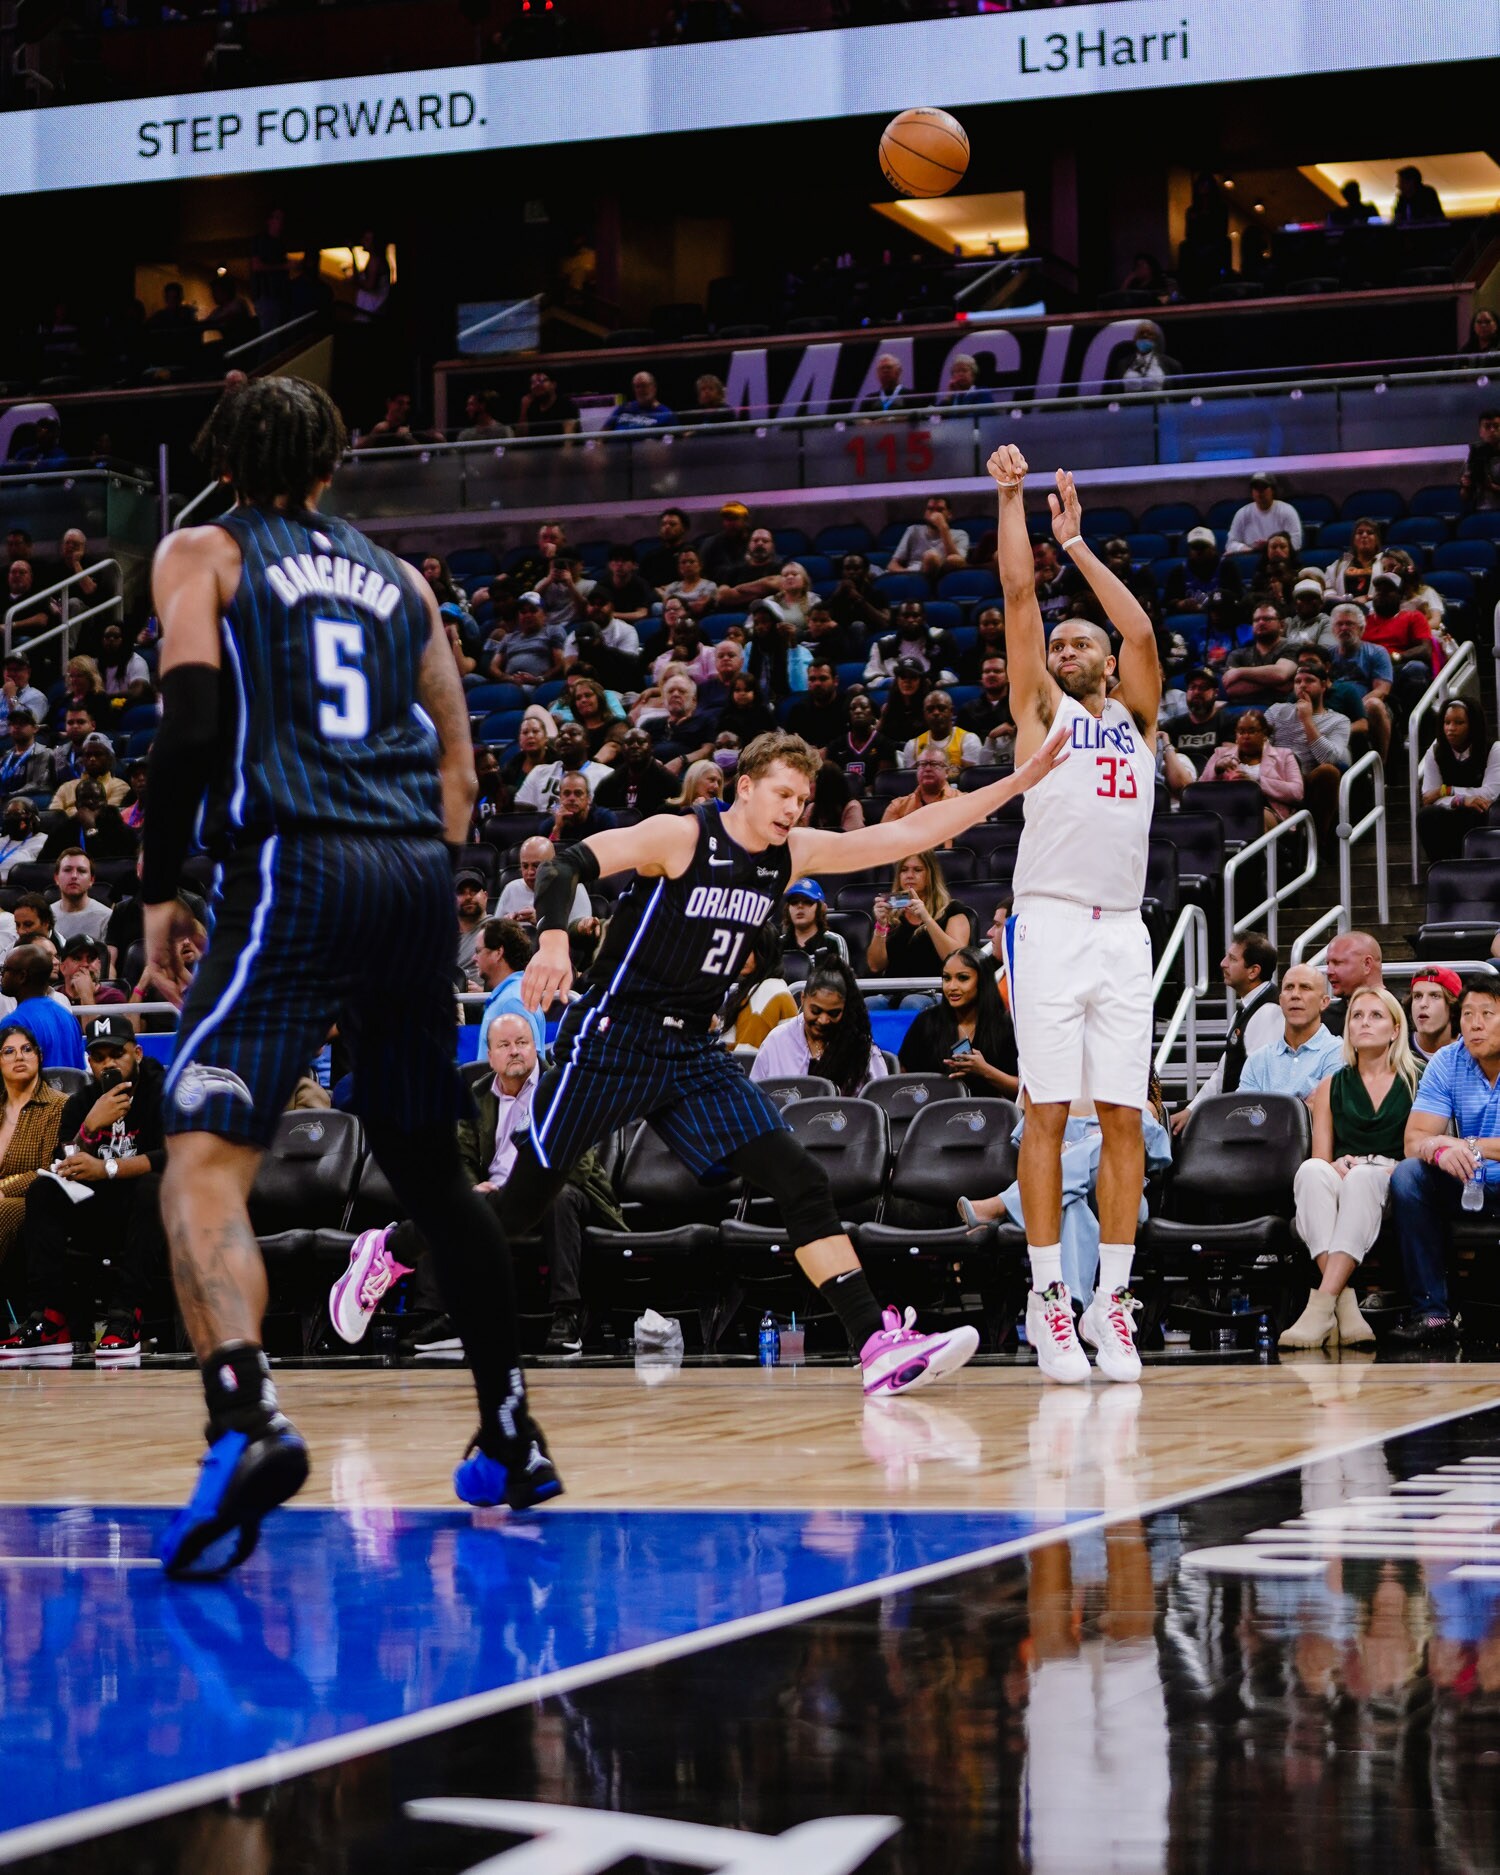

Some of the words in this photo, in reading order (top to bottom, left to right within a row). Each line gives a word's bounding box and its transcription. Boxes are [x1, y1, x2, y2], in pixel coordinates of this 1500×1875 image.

[1019, 19, 1189, 74] L3Harri
[138, 113, 242, 158] STEP
[257, 91, 488, 146] FORWARD.
[847, 431, 934, 477] 115
[265, 553, 401, 621] BANCHERO
[314, 617, 369, 739] 5
[1180, 733, 1214, 746] YETI
[1096, 756, 1138, 798] 33
[708, 836, 718, 851] 6
[685, 887, 775, 927] ORLAND
[701, 928, 745, 976] 21
[94, 1017, 112, 1037] M
